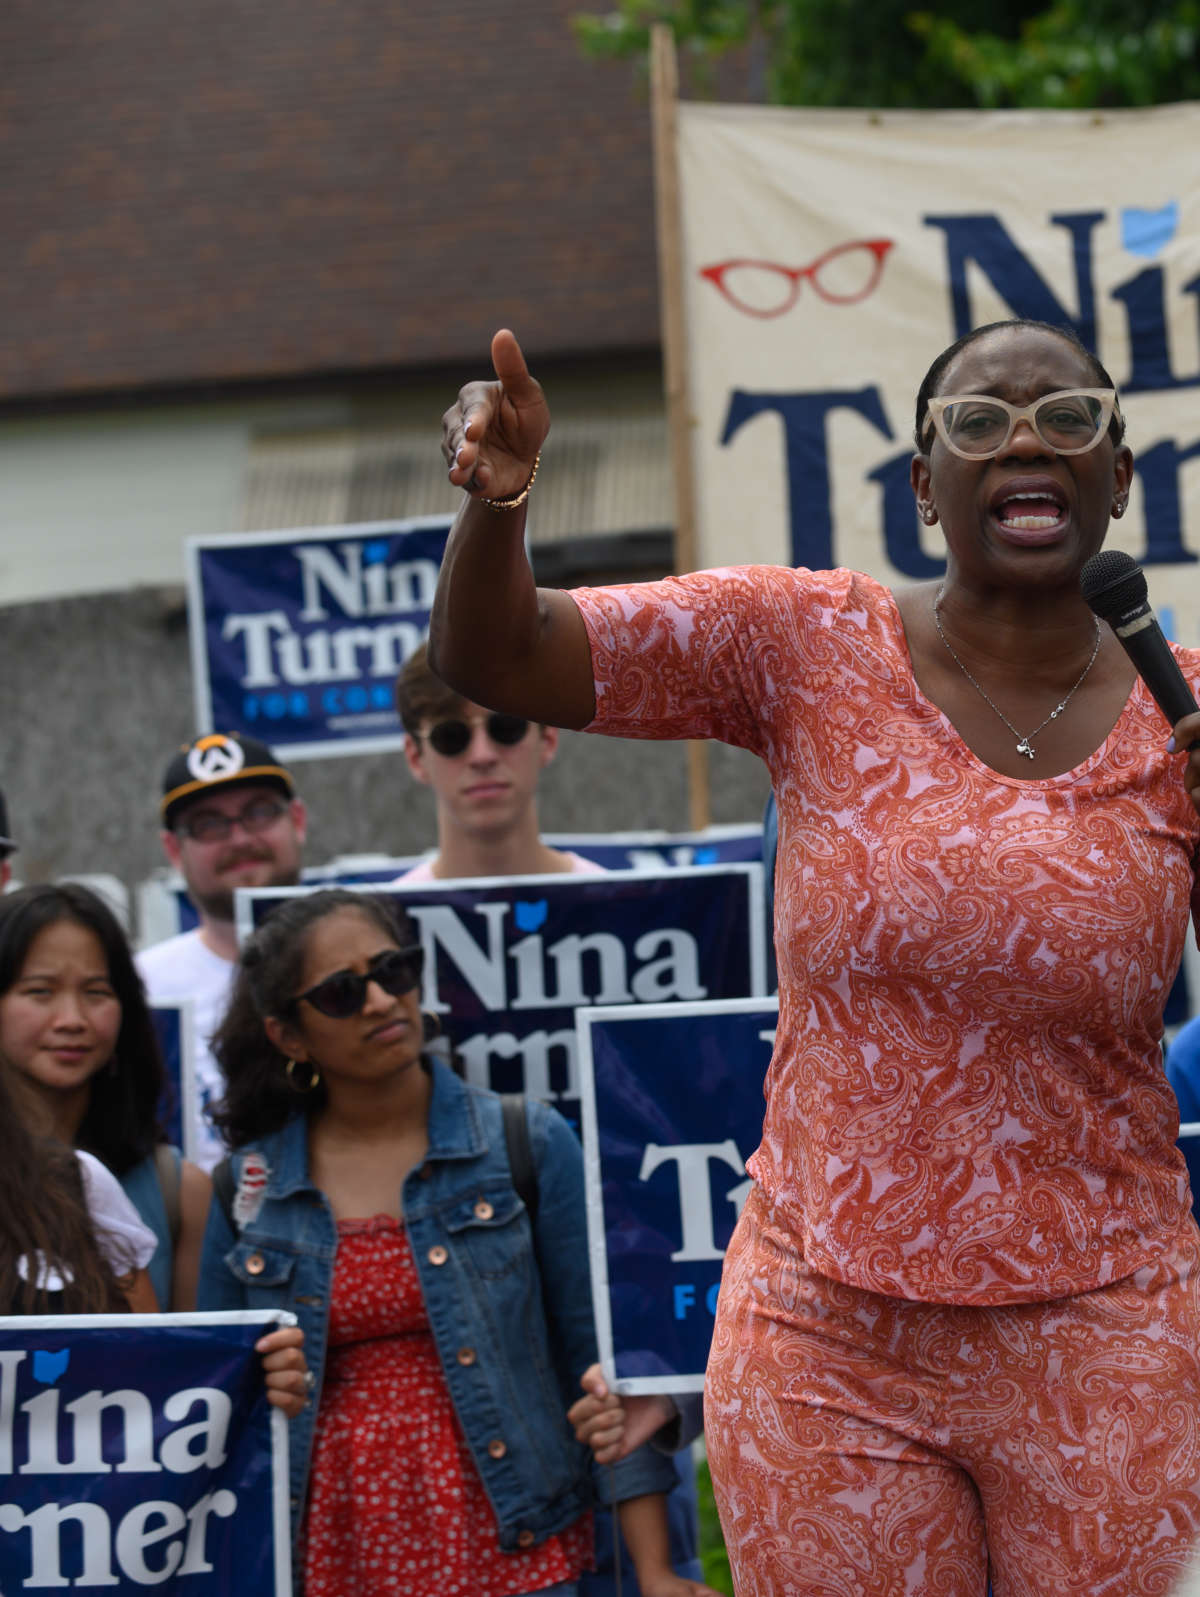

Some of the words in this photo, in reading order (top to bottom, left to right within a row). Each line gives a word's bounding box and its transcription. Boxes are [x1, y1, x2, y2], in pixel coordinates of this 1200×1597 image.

[293, 540, 438, 622] Nin
[221, 609, 430, 689] Turn
[406, 898, 708, 1014] Nina
[0, 1489, 238, 1588] ner
